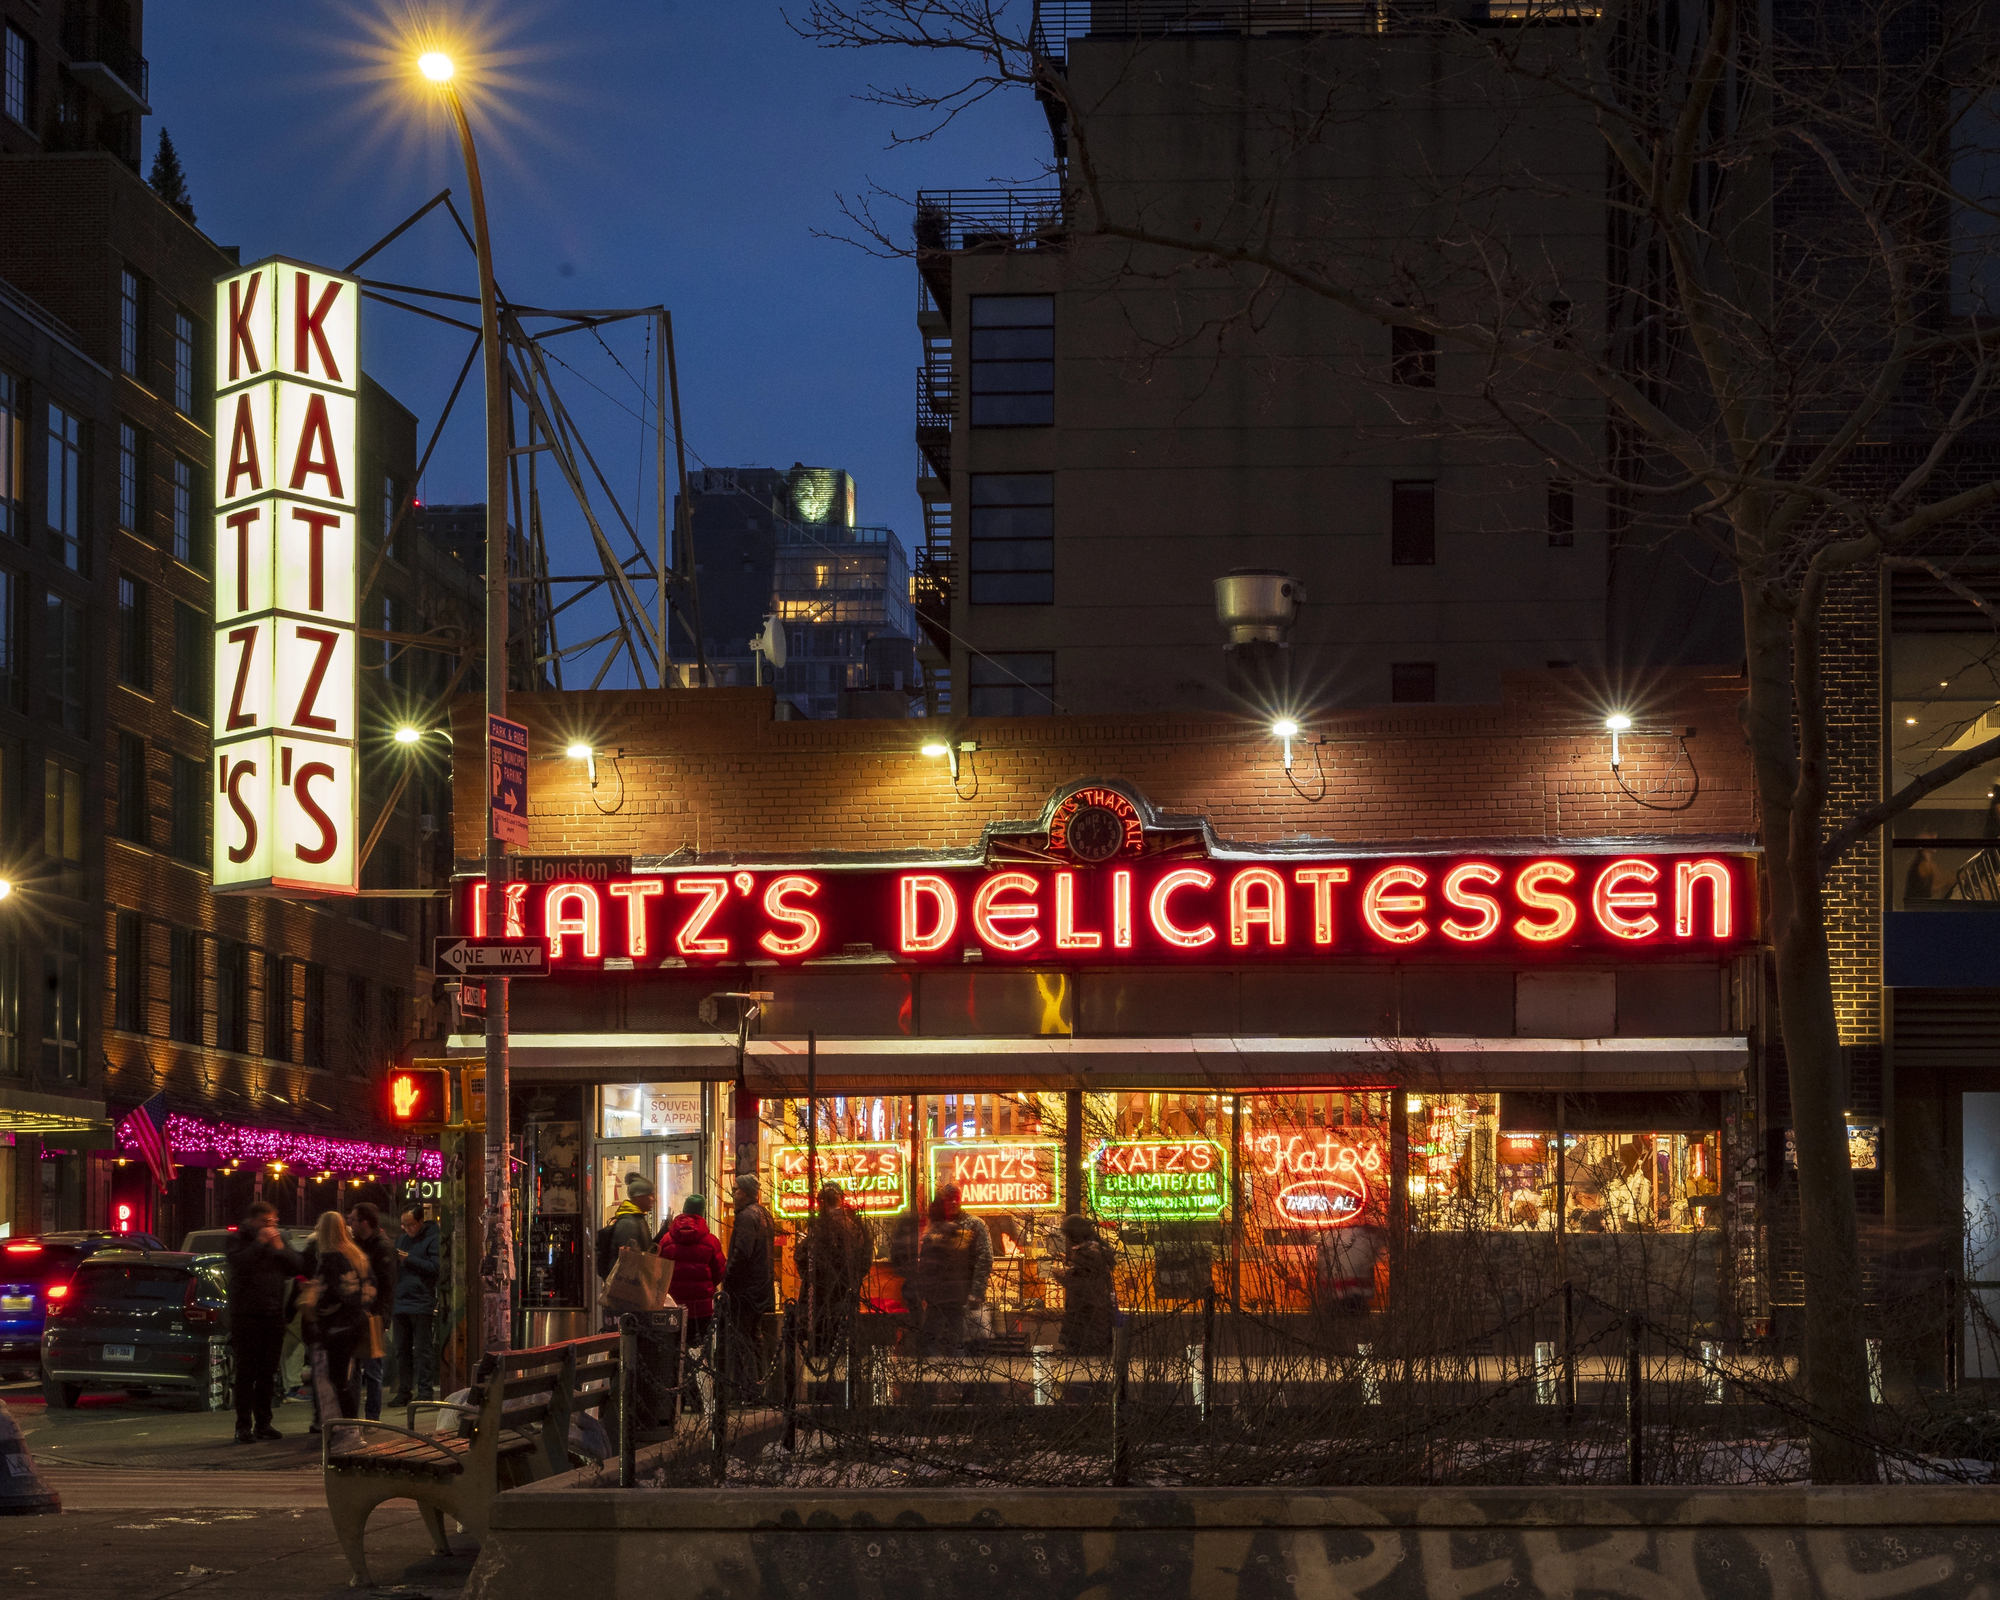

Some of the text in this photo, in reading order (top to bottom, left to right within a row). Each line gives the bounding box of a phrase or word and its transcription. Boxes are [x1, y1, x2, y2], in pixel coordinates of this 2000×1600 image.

[219, 270, 263, 864] KATZ'S
[280, 271, 344, 865] KATZ'S
[492, 723, 506, 739] PARK
[503, 766, 522, 785] PARKING
[515, 858, 628, 881] E Houston St
[900, 858, 1733, 953] DELICATESSEN
[452, 949, 535, 964] ONE WAY
[466, 988, 479, 1005] ONE
[651, 1112, 659, 1124] &
[1510, 1138, 1534, 1149] BEER
[1105, 1142, 1211, 1173] KATZ'S
[865, 1195, 900, 1206] BEST
